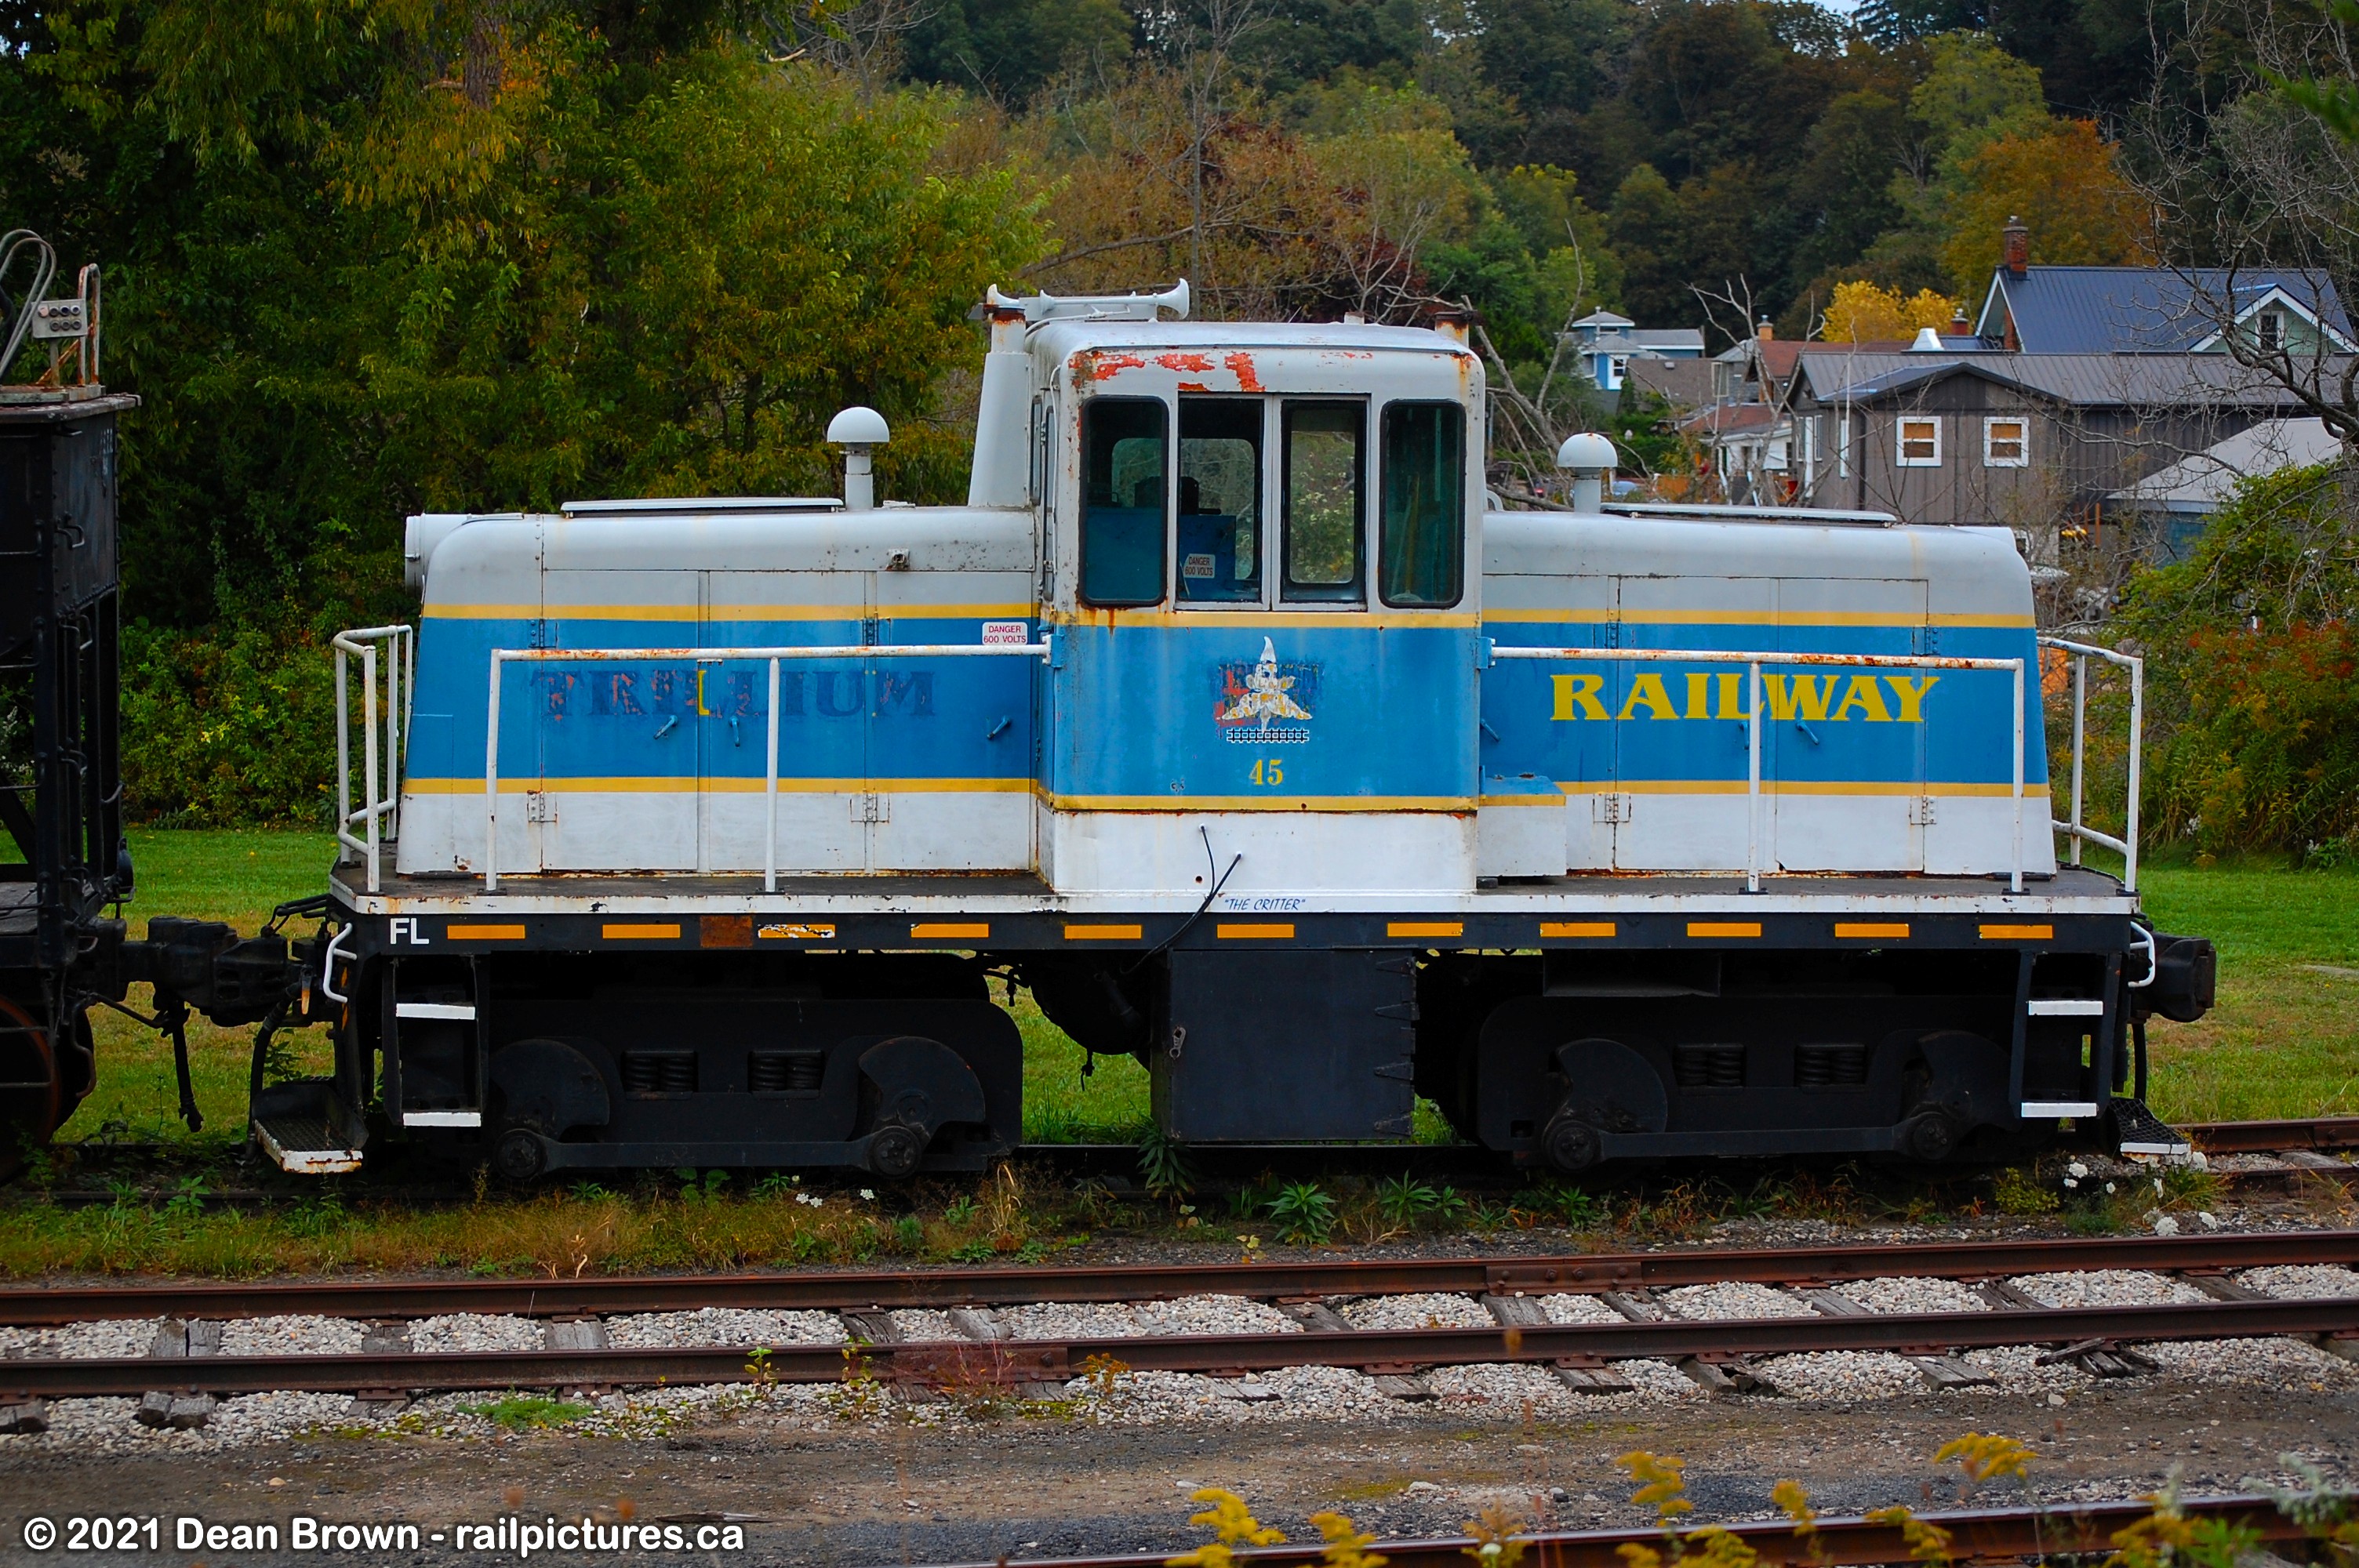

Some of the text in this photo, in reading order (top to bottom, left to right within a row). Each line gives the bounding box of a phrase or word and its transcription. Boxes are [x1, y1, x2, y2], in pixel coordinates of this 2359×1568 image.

[1189, 557, 1210, 565] DANGER
[1185, 566, 1213, 576] 600 VOLTS
[988, 625, 1021, 633] DANGER
[1550, 673, 1940, 722] RAILWAY
[1249, 759, 1284, 786] 45
[390, 917, 430, 945] FL
